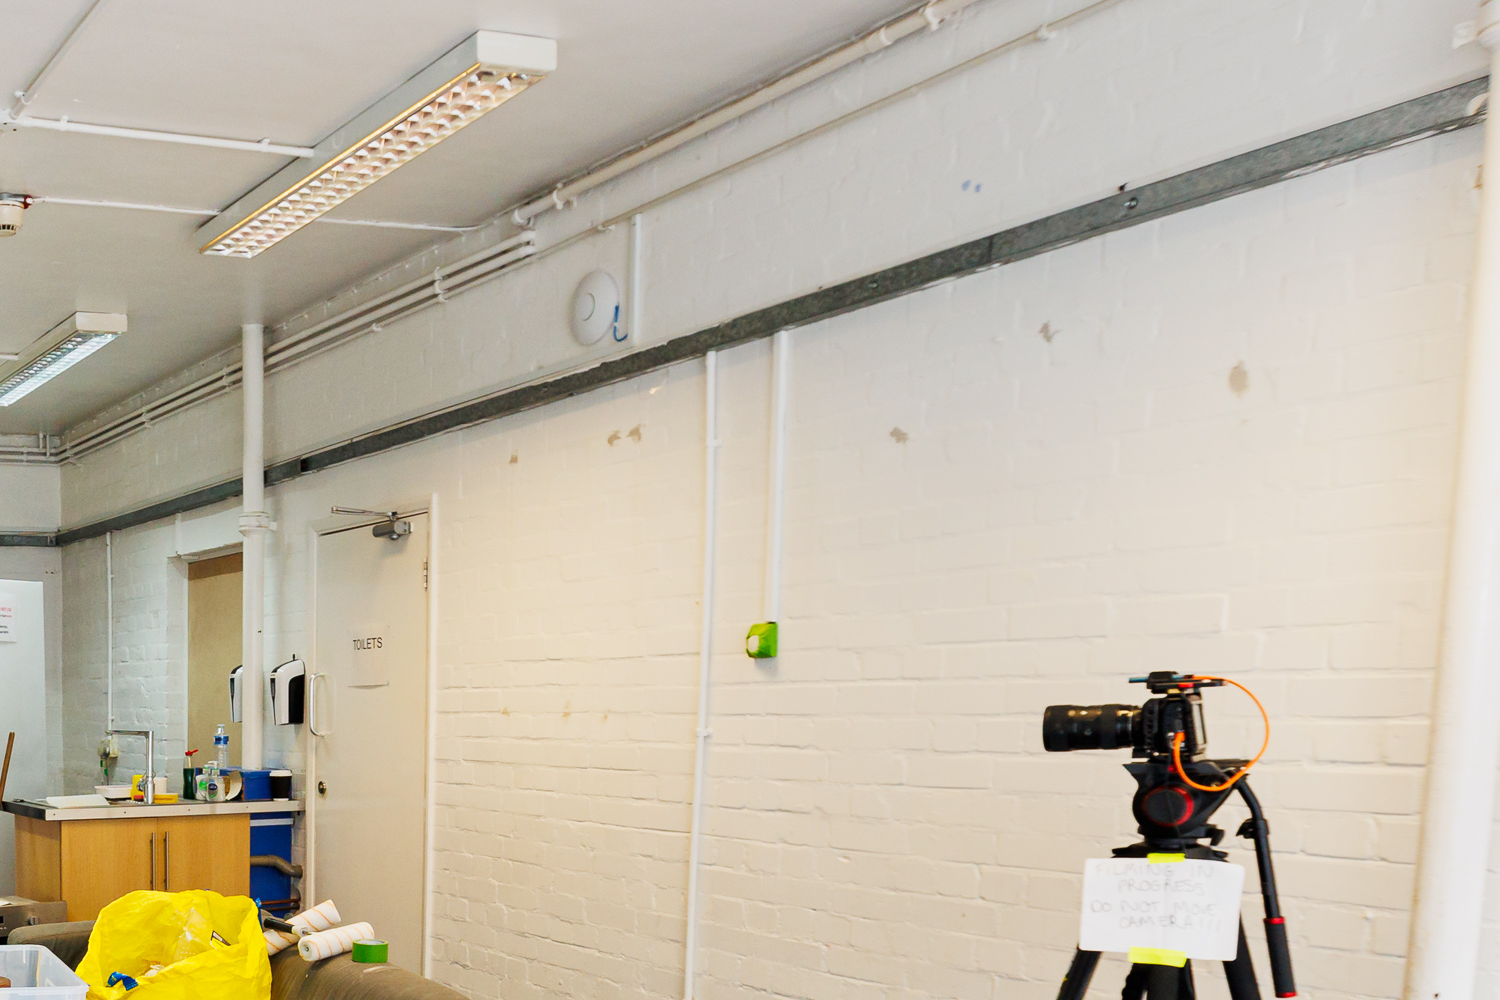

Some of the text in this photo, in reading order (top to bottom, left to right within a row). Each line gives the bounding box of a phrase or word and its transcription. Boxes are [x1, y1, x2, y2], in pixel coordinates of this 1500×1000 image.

[352, 636, 383, 650] TOILETS
[1094, 863, 1214, 878] FILMING IN
[1118, 878, 1205, 896] PROGRESS
[1091, 899, 1219, 916] DO NOT MOVE
